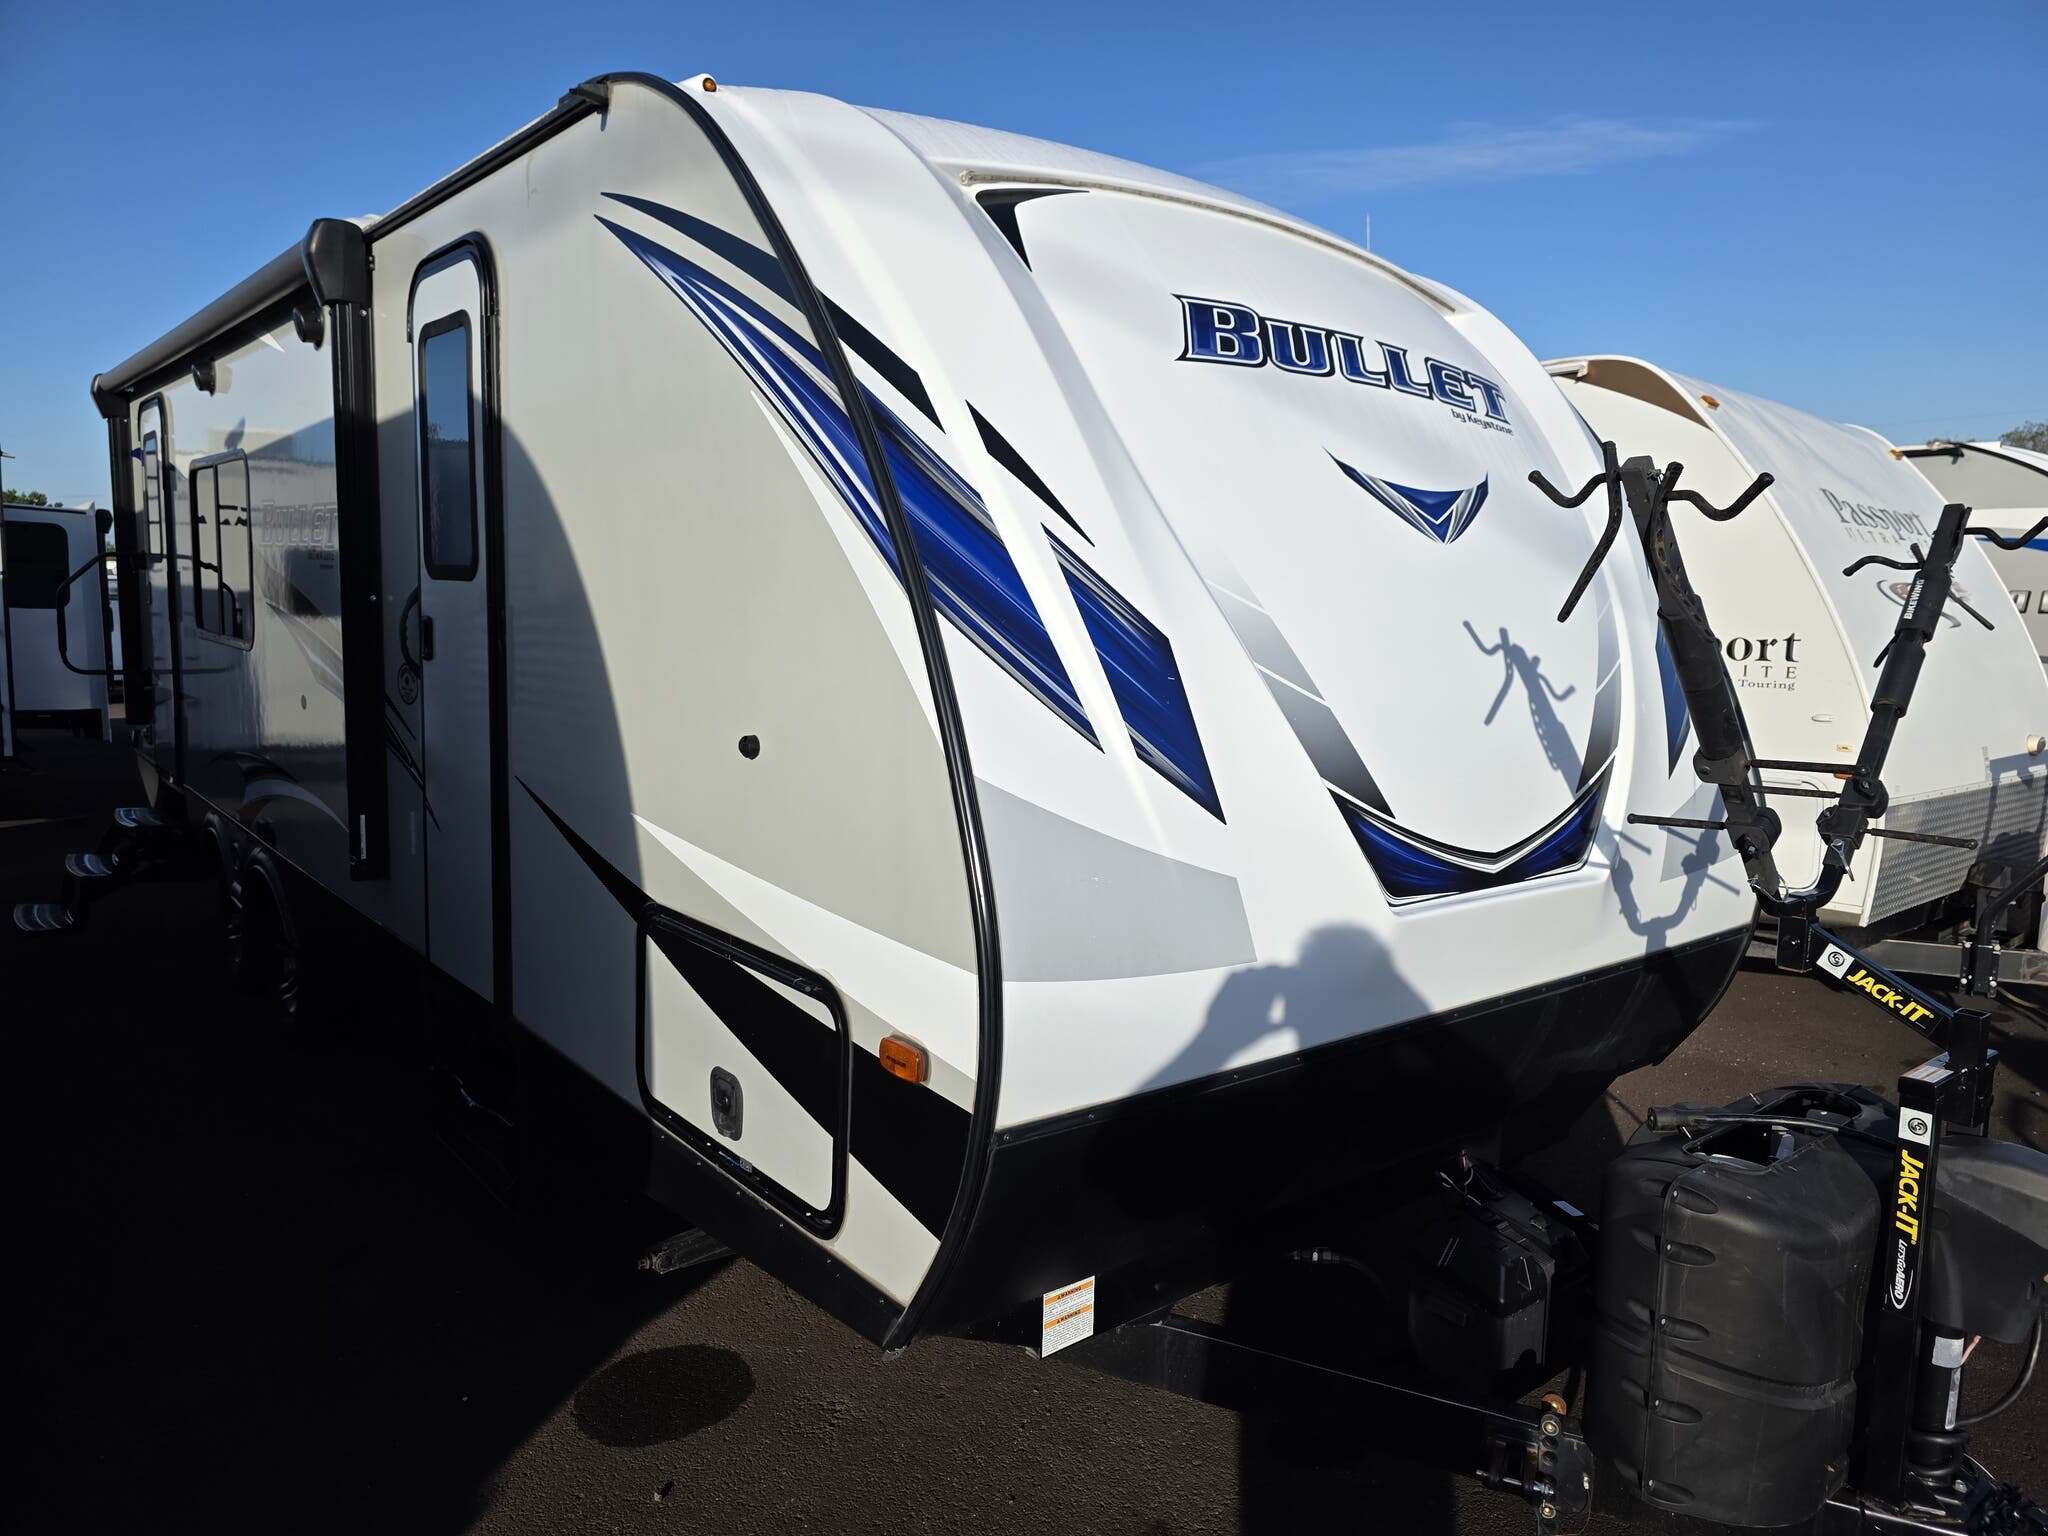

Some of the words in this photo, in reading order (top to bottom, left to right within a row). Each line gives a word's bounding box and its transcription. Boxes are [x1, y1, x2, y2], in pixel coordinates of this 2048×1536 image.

[1171, 293, 1510, 425] BULLET
[1451, 408, 1467, 423] by
[1466, 413, 1514, 436] Keystone
[1819, 487, 1933, 541] Passport
[1903, 579, 1925, 620] BIKEWING
[1738, 679, 1796, 692] Touring
[1846, 969, 1933, 1022] JACK-IT
[1895, 1149, 1924, 1243] JACK-IT
